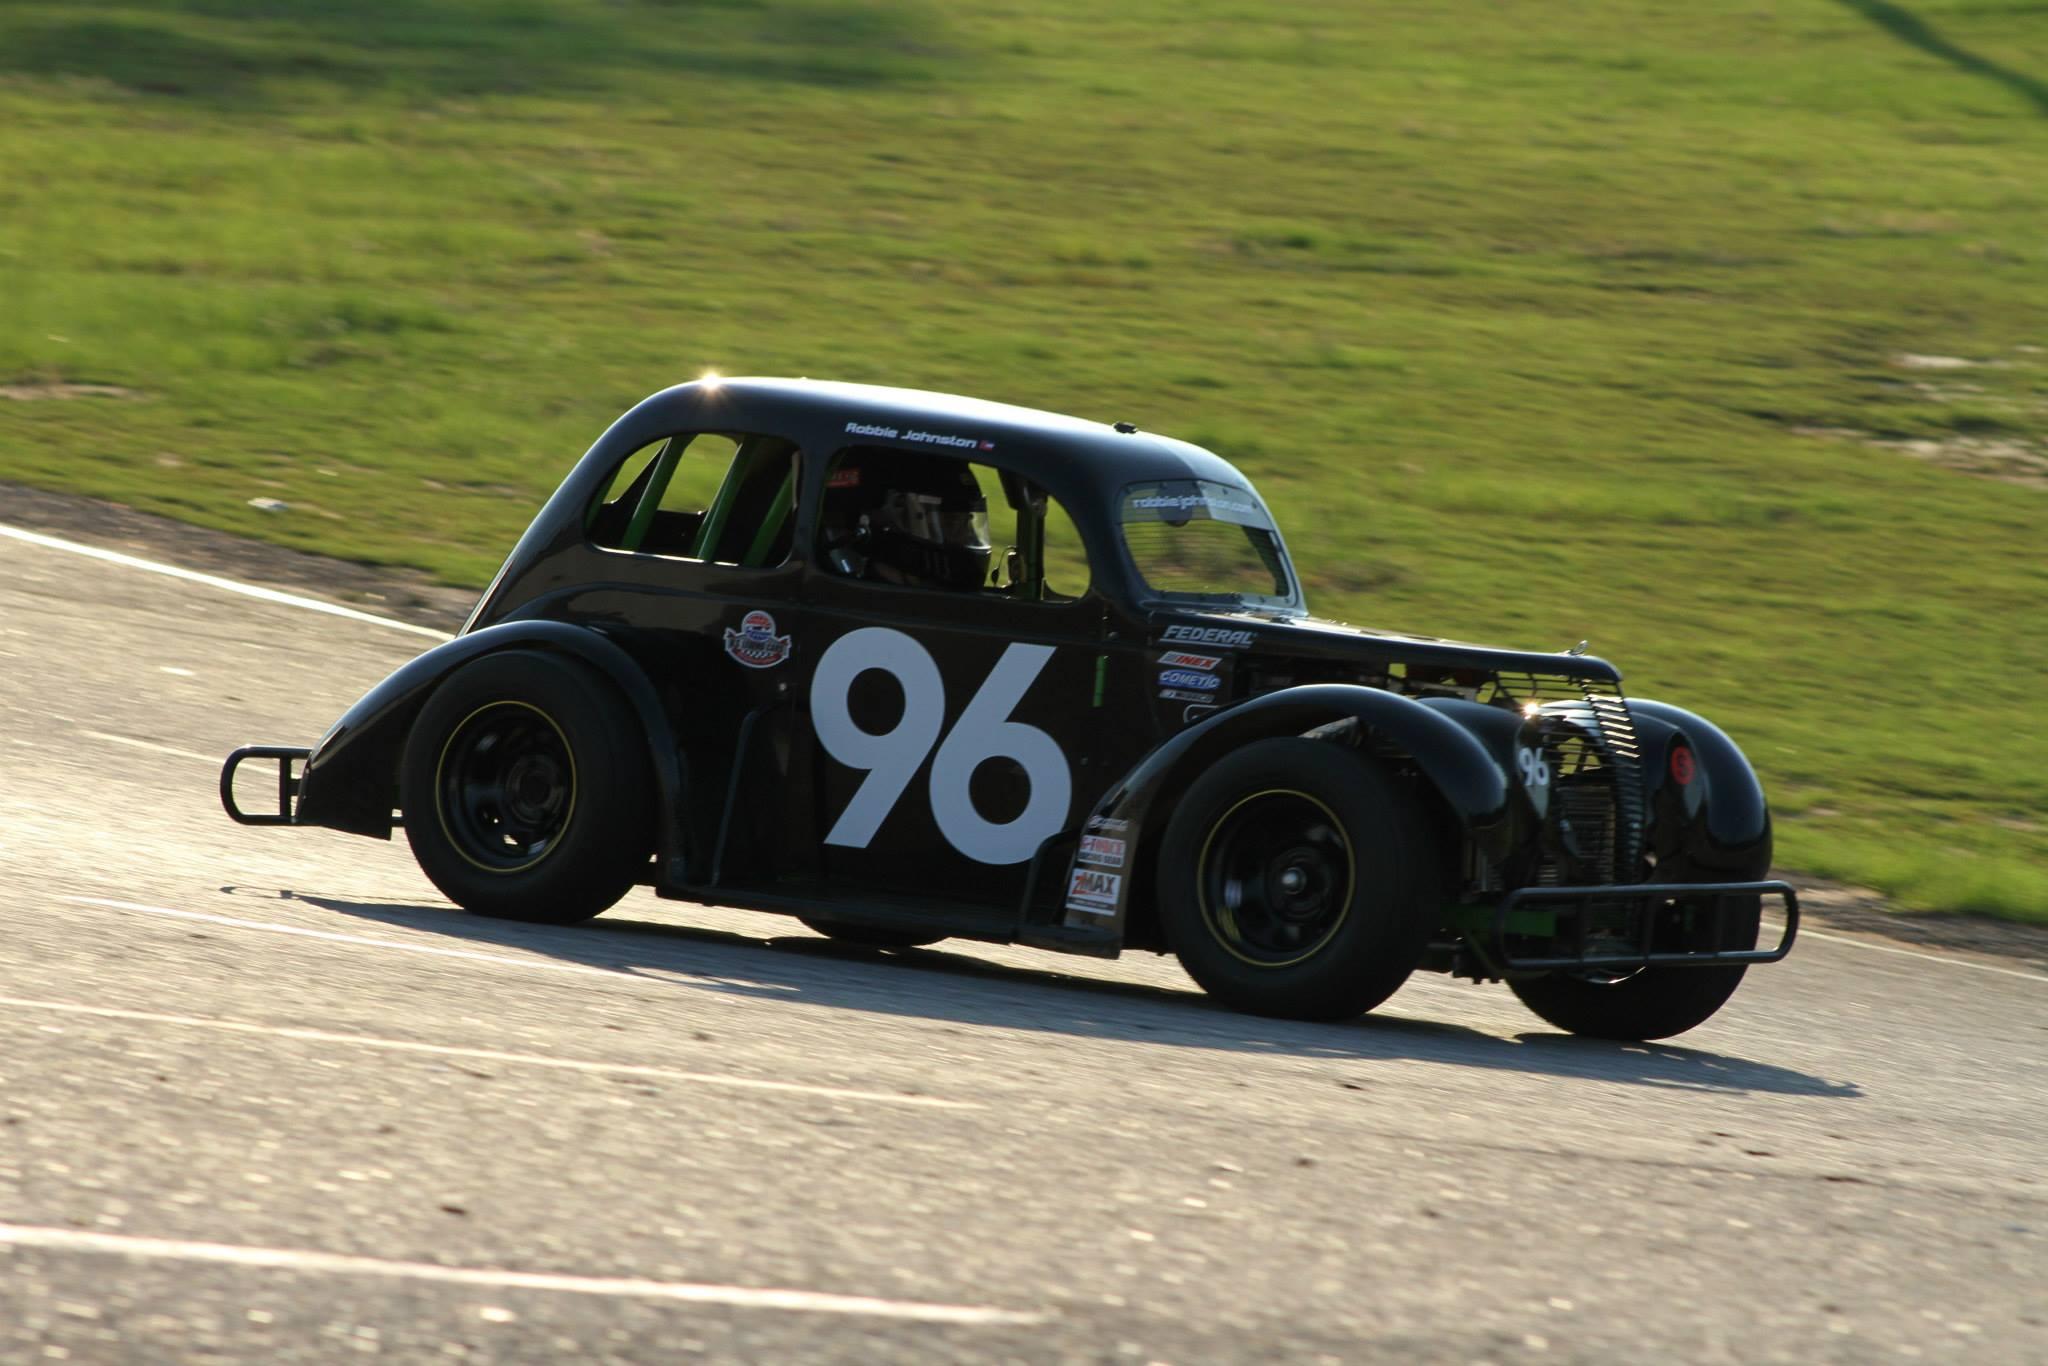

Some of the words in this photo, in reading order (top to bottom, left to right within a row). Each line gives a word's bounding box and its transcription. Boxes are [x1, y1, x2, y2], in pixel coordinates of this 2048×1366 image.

[845, 422, 898, 439] Robbie
[901, 429, 977, 449] Johnston
[1163, 625, 1254, 645] FEDERAL
[1175, 655, 1214, 668] INEX
[1160, 670, 1221, 689] COMETIC
[810, 626, 1073, 865] 96
[1518, 747, 1549, 786] 96
